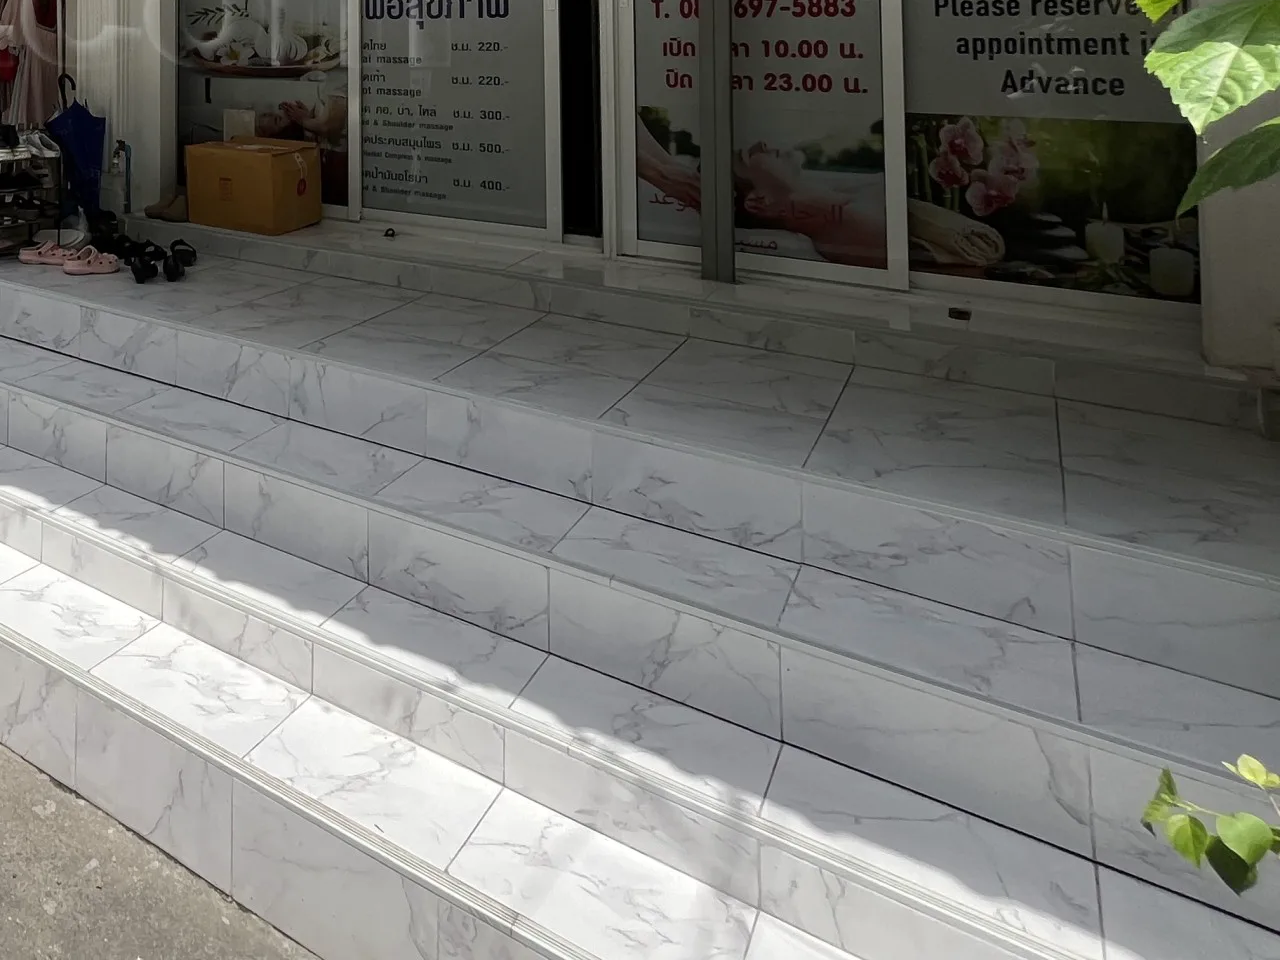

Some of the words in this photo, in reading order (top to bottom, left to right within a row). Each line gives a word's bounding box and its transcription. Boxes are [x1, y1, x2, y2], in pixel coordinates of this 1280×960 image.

[761, 39, 829, 59] 10.00
[955, 30, 1131, 61] appointment
[376, 55, 423, 67] massage
[763, 72, 833, 93] 23.00
[1000, 68, 1126, 96] Advance
[376, 87, 422, 99] massage
[418, 123, 454, 132] massage
